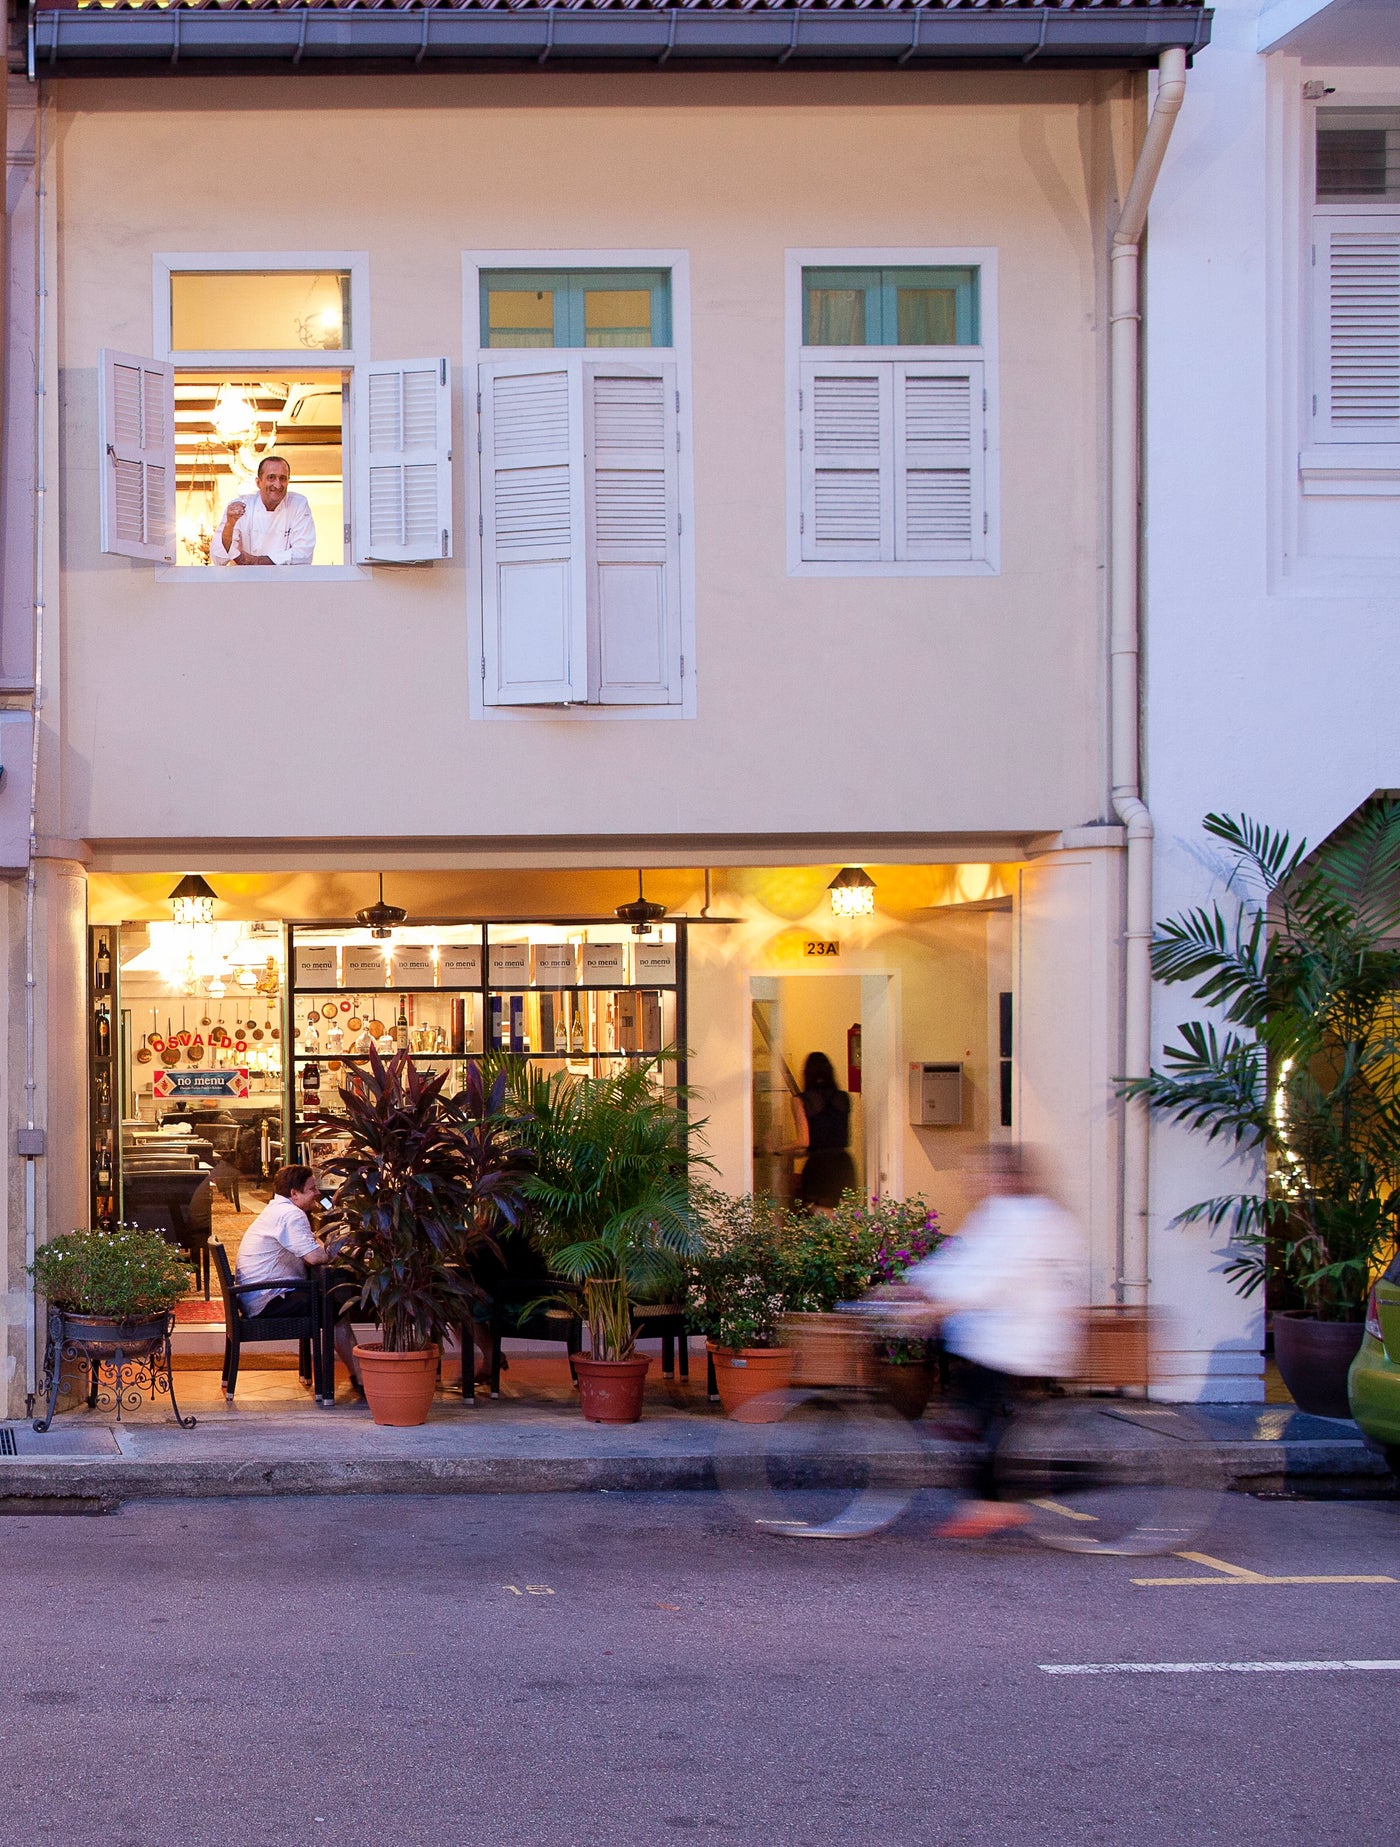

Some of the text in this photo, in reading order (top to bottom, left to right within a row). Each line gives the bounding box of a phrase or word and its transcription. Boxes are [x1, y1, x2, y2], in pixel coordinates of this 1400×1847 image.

[807, 942, 837, 955] 23A
[152, 1033, 248, 1053] OSVALDO
[177, 1077, 225, 1086] no menu
[501, 1584, 556, 1595] 15
